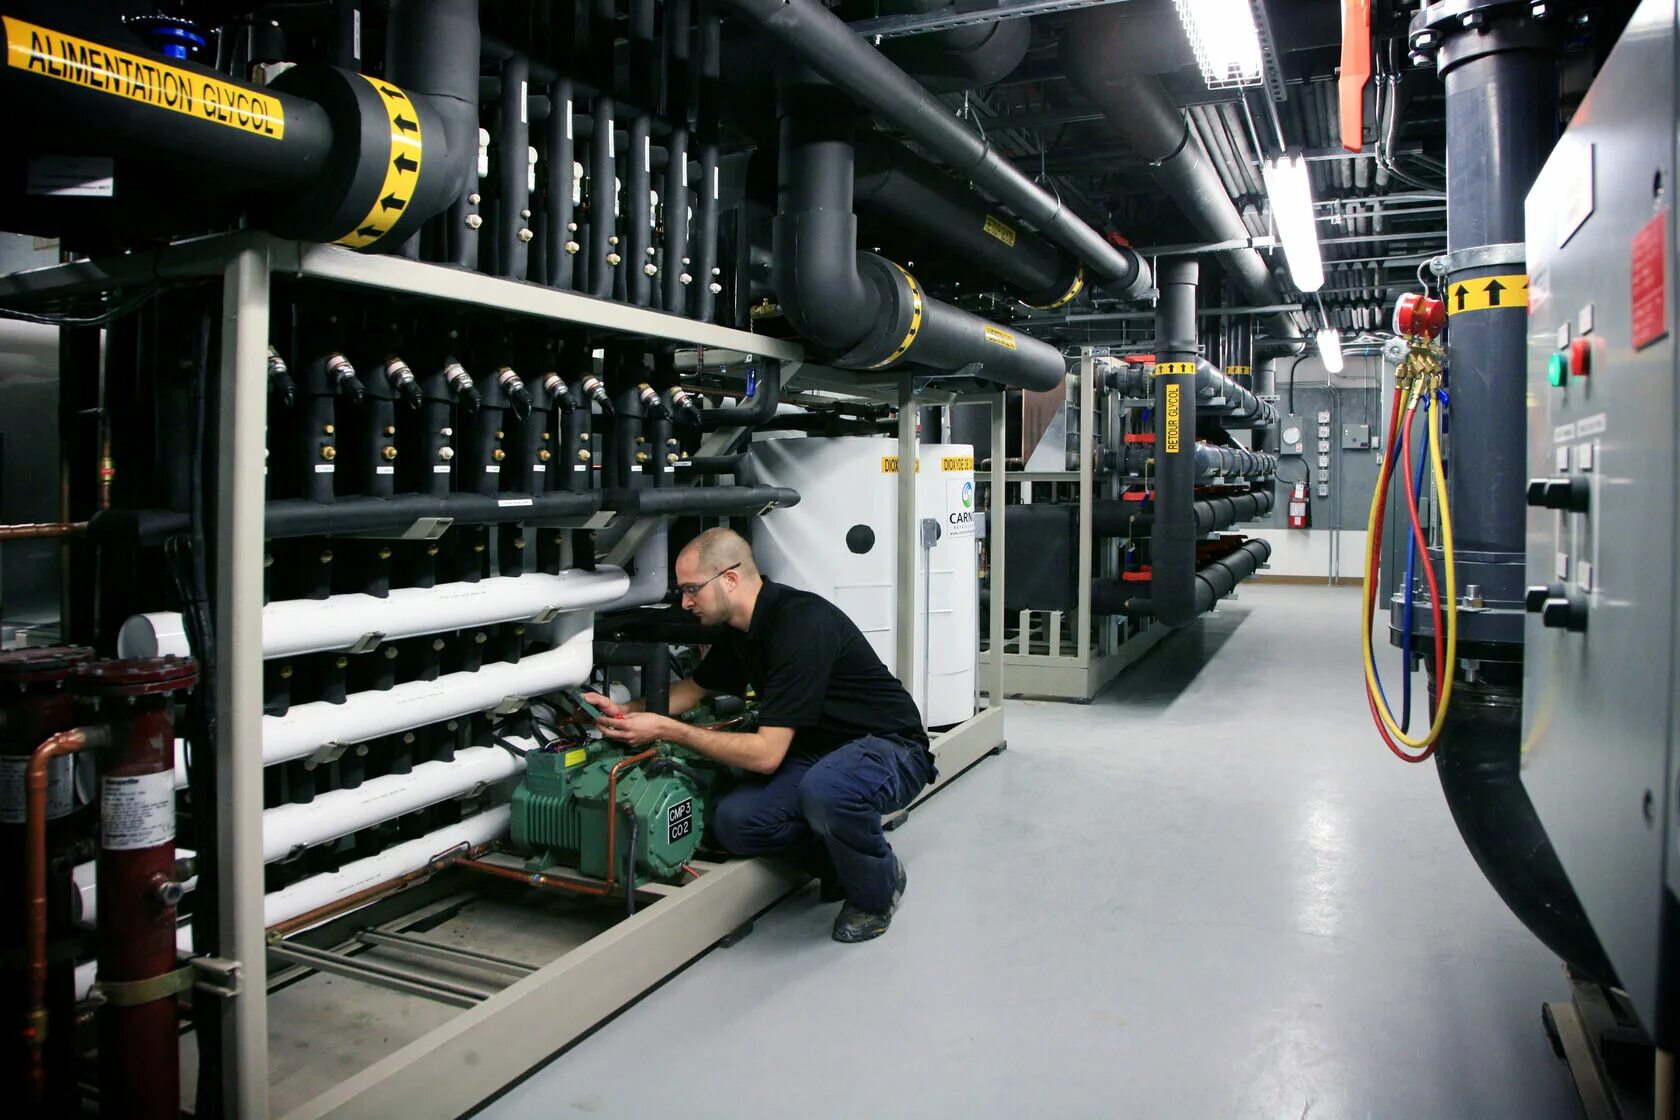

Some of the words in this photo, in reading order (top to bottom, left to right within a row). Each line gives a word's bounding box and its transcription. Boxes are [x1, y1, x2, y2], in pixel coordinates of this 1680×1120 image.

[28, 31, 193, 113] ALIMENTATION
[203, 83, 275, 135] GLYCOL
[1168, 388, 1179, 417] GLYCOL
[1168, 420, 1178, 450] RETOUR
[884, 459, 898, 472] DIOX
[949, 512, 975, 524] CARN
[670, 804, 685, 821] CMP
